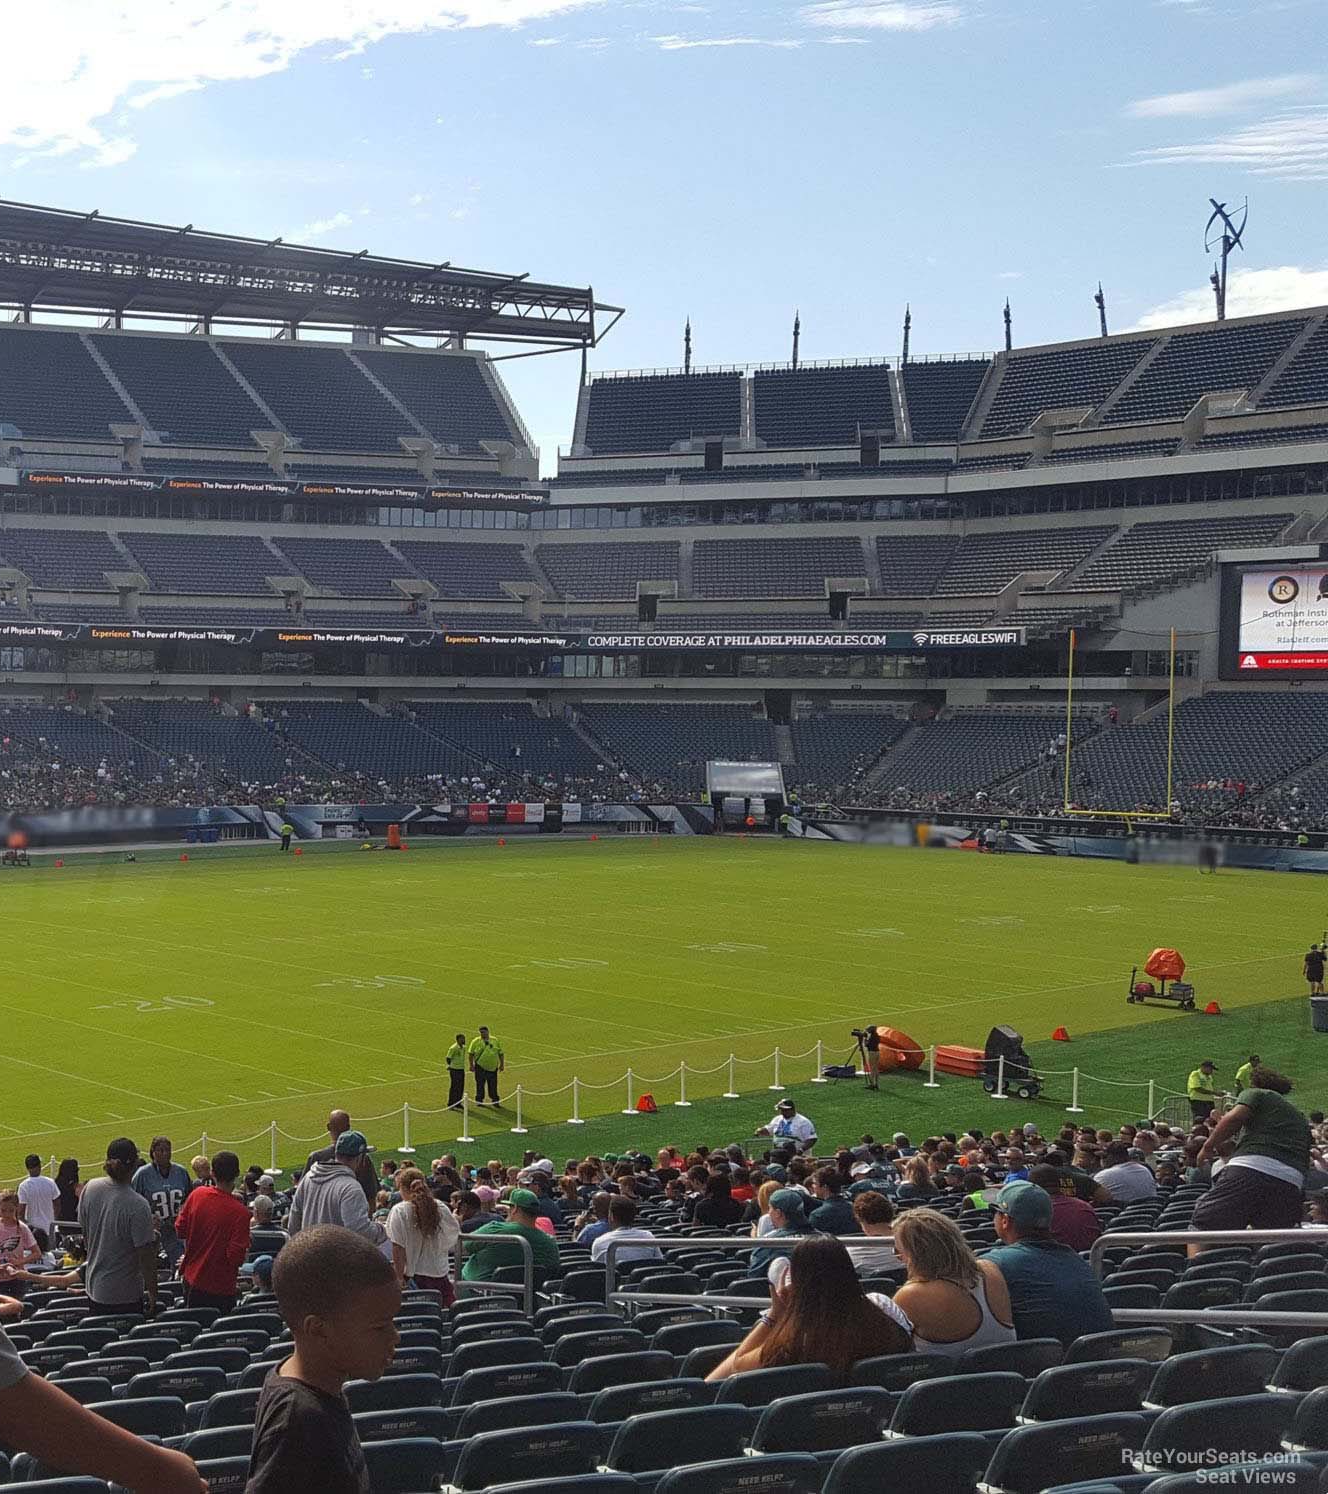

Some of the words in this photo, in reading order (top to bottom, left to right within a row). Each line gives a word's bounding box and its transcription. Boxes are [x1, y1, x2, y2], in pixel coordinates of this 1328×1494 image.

[29, 473, 62, 483] Experience
[64, 475, 75, 483] The
[77, 476, 95, 484] Power
[104, 477, 128, 486] Physical
[130, 478, 154, 489] Therapy
[170, 480, 201, 489] Experience
[203, 481, 213, 489] The
[215, 482, 232, 490] Power
[241, 483, 263, 491] Physical
[265, 484, 288, 493] Therapy
[304, 485, 334, 494] Experience
[347, 487, 363, 495] Power
[372, 488, 394, 497] Physical
[396, 489, 417, 500] Therapy
[432, 490, 461, 498] Experience
[498, 492, 520, 500] Physical
[521, 493, 543, 503] Therapy
[10, 627, 36, 635] Physical
[37, 628, 62, 636] Therapy
[177, 632, 205, 640] Physical
[207, 632, 235, 640] Therapy
[279, 633, 312, 642] Experience
[314, 633, 324, 641] The
[326, 633, 344, 641] Power
[354, 634, 378, 643] Physical
[380, 634, 404, 644] Therapy
[445, 635, 478, 644] Experience
[492, 636, 509, 644] Power
[518, 636, 541, 644] Physical
[543, 636, 566, 646] Therapy
[588, 636, 645, 647] COMPLETE
[647, 636, 705, 647] COVERAGE
[707, 636, 722, 647] AT
[724, 634, 886, 647] PHILADELPHIAEAGLES.COM
[930, 632, 1017, 645] FREEEAGLESWIFI
[152, 1189, 183, 1219] 36
